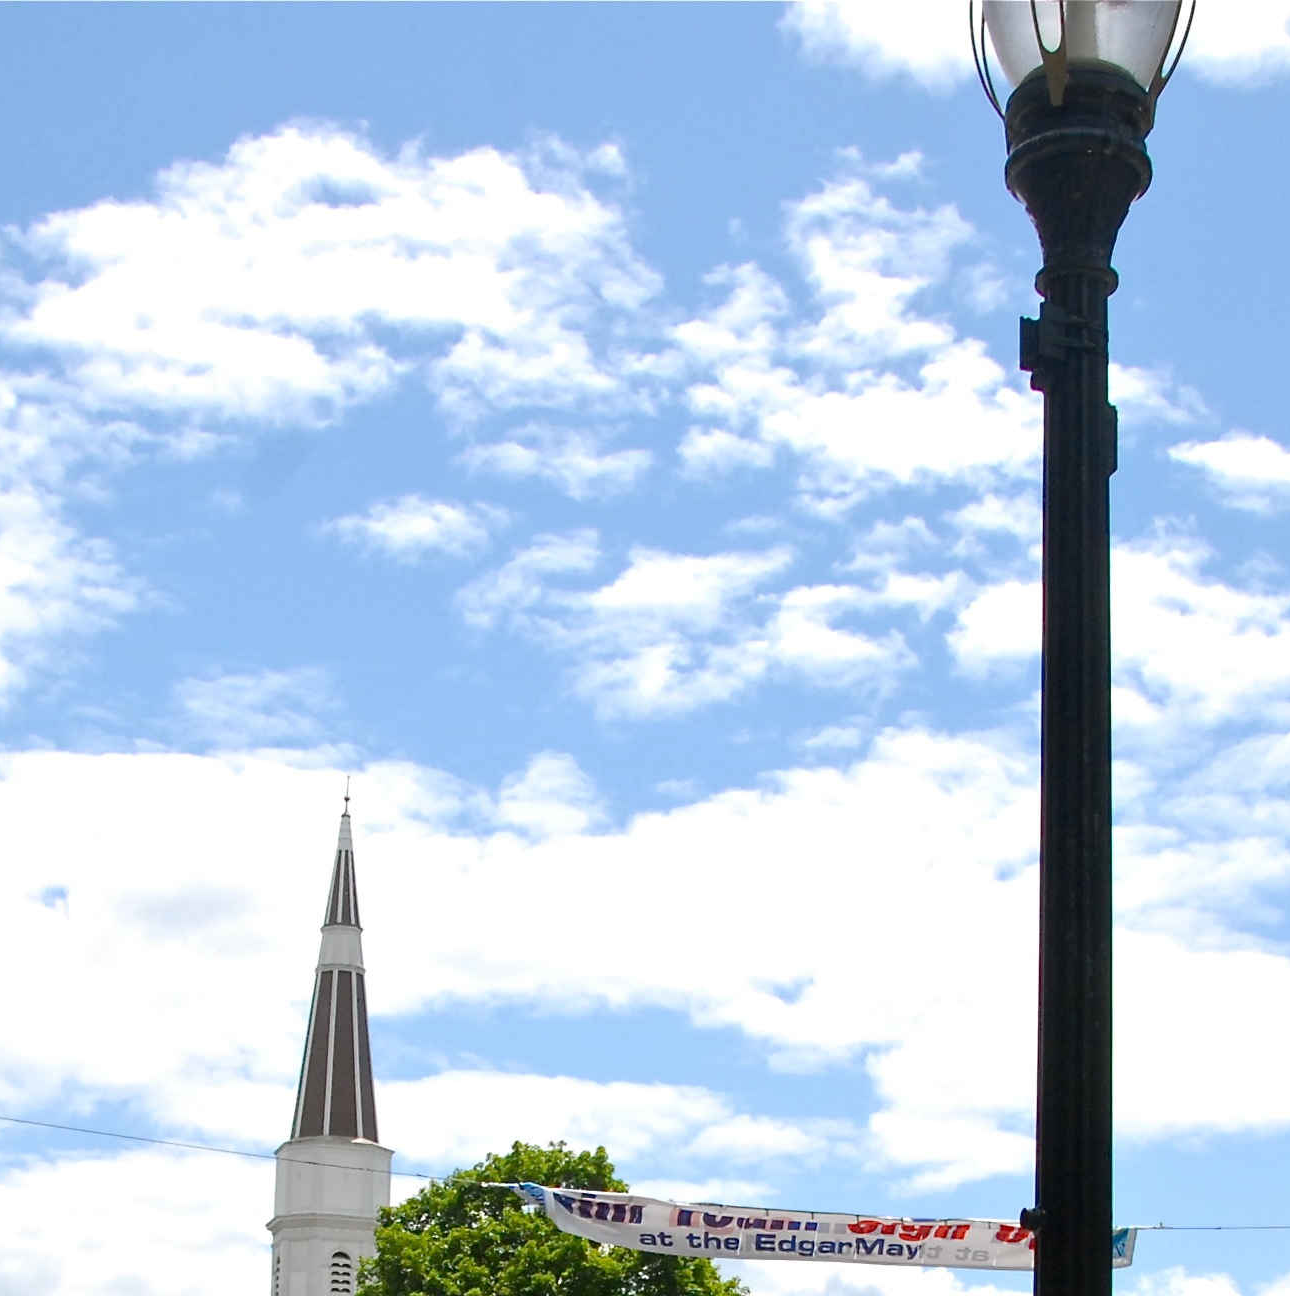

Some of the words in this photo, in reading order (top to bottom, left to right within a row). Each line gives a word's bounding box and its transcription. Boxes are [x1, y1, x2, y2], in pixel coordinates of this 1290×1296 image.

[640, 1231, 673, 1247] at
[686, 1232, 740, 1251] the
[755, 1233, 923, 1261] EdgarMay
